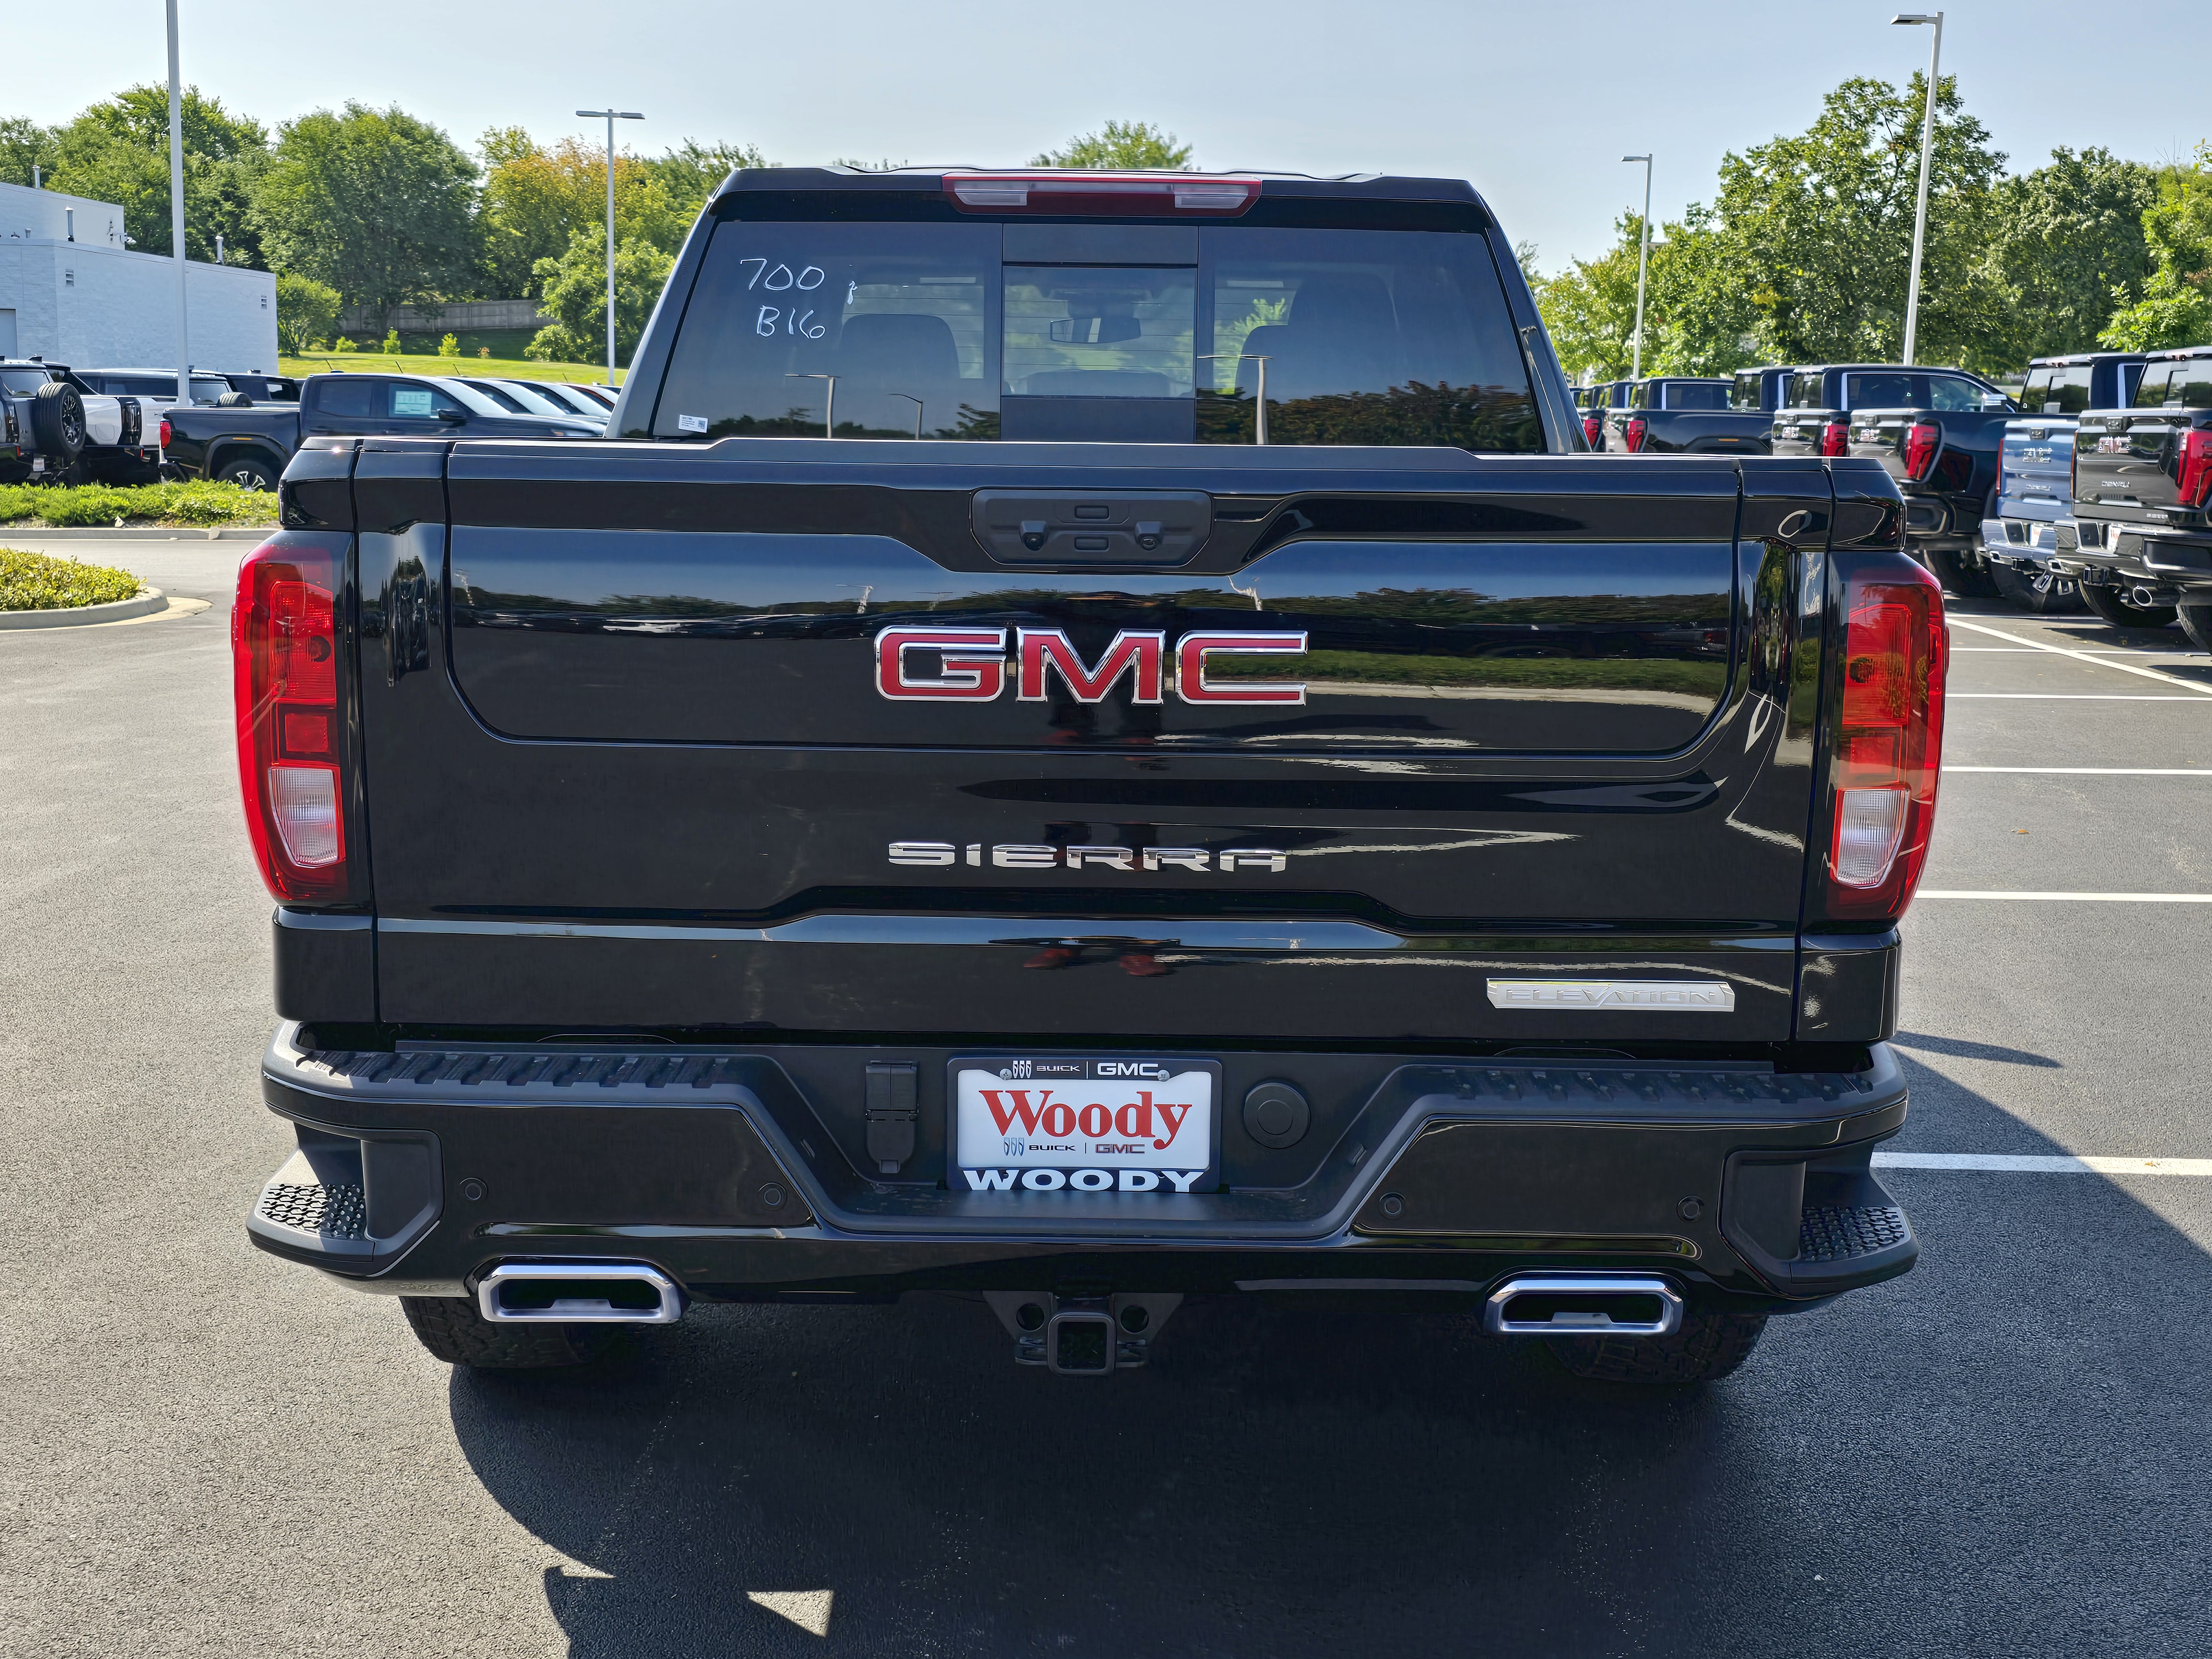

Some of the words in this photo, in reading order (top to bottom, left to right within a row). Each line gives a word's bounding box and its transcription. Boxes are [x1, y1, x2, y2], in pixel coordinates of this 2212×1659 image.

[740, 258, 825, 290] 700
[757, 305, 826, 338] B16
[874, 625, 1308, 706] GMC
[888, 841, 1287, 872] SIERRA
[1506, 987, 1716, 1004] ELEVATION
[1097, 1062, 1159, 1077] GMC
[978, 1090, 1193, 1150] Woody
[1095, 1144, 1145, 1154] GMC
[963, 1169, 1204, 1192] WOODY
